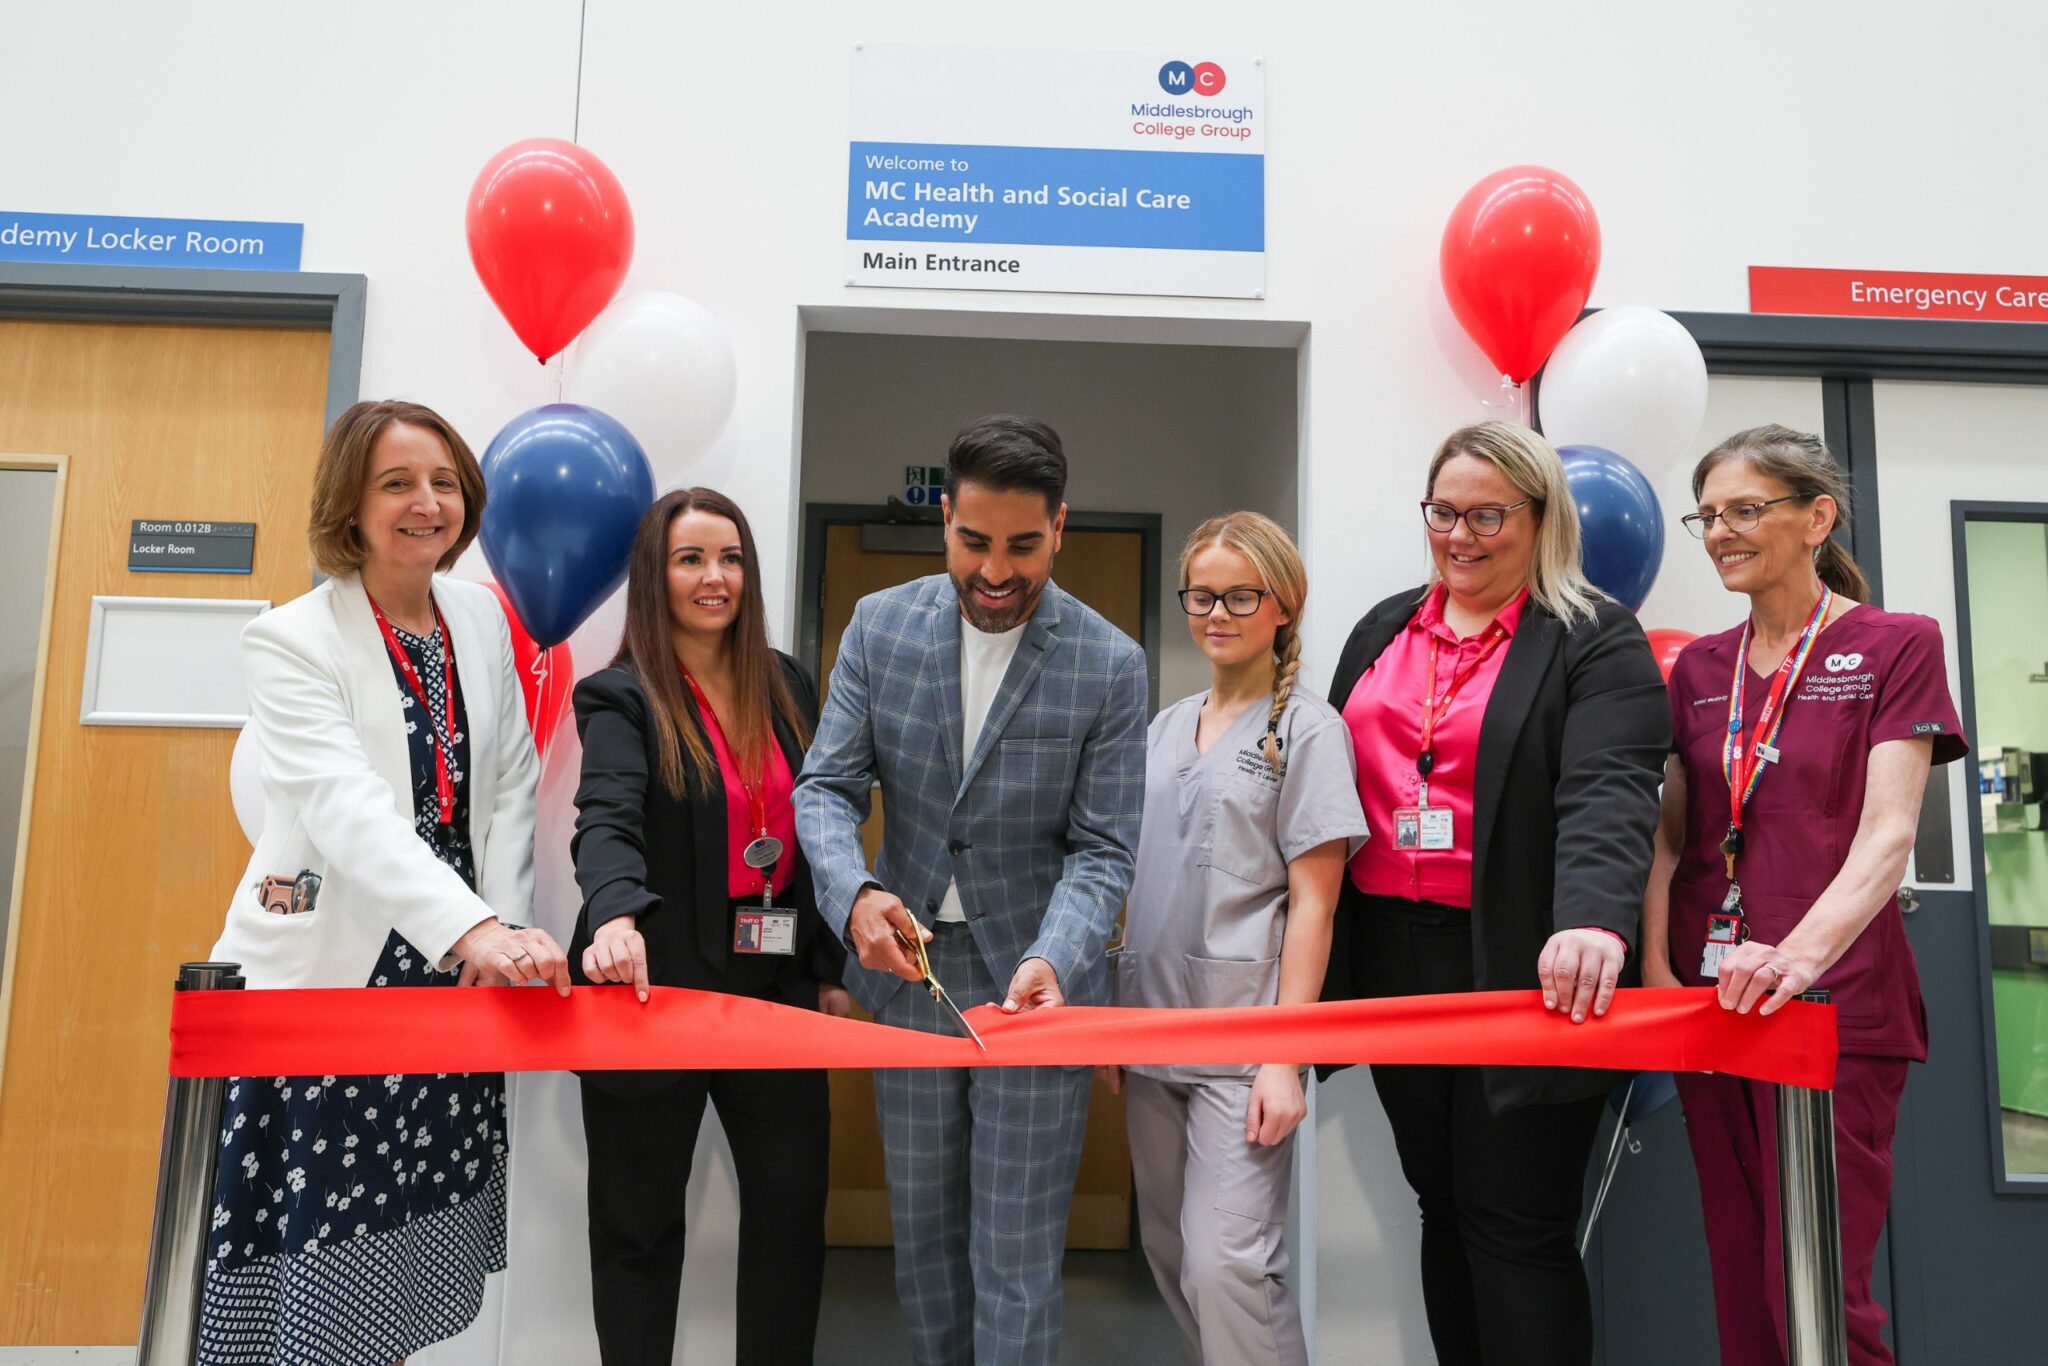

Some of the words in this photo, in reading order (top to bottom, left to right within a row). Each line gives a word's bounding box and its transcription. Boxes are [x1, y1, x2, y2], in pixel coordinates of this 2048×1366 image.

[1131, 103, 1254, 123] Middlesbrough
[1132, 122, 1196, 138] College
[1201, 124, 1252, 141] Group
[865, 154, 945, 172] Welcome
[950, 156, 969, 172] to
[865, 181, 906, 201] MC
[914, 182, 994, 204] Health
[1002, 185, 1049, 206] and
[1057, 187, 1128, 208] Social
[1136, 190, 1192, 209] Care
[863, 208, 978, 234] Academy
[1, 223, 78, 252] demy
[86, 228, 177, 252] Locker
[186, 231, 264, 255] Room
[862, 251, 918, 271] Main
[925, 254, 1021, 274] Entrance
[1851, 281, 1988, 312] Emergency
[1996, 286, 2048, 308] Care
[139, 522, 172, 533] Room
[175, 523, 212, 534] 0.012B
[132, 544, 165, 554] Locker
[168, 544, 195, 555] Room
[1778, 655, 1794, 674] TTE
[1806, 672, 1875, 685] Middlesbrough
[1797, 693, 1820, 701] Health
[1822, 694, 1836, 702] and
[1837, 692, 1857, 701] Social
[1859, 692, 1874, 701] Care
[1806, 685, 1841, 694] College
[1842, 683, 1872, 694] Group
[1236, 756, 1264, 771] College
[1238, 765, 1256, 776] Health
